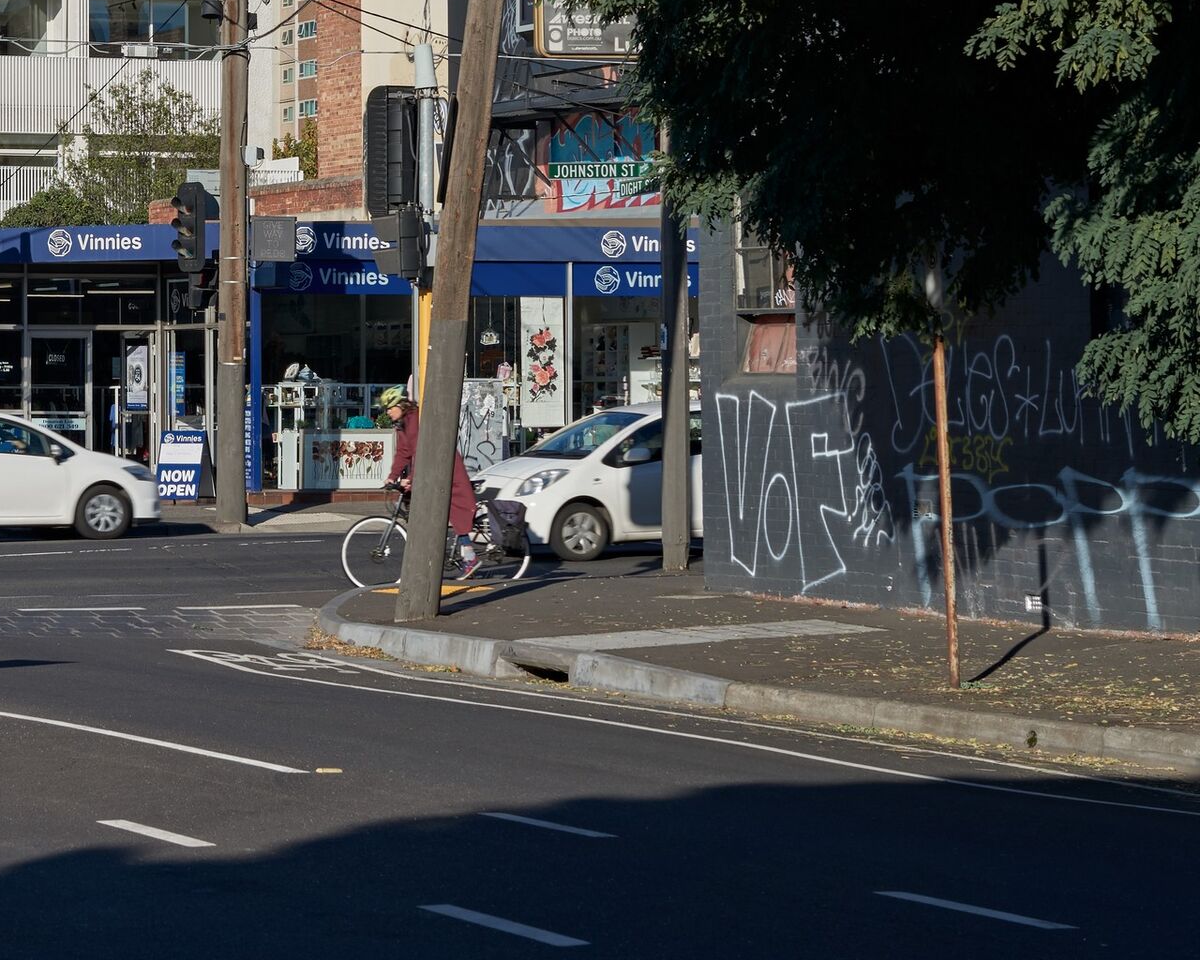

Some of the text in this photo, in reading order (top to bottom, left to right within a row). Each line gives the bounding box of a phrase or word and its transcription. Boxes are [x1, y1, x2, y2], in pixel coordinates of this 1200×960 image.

[566, 27, 602, 37] PHOTO
[554, 164, 617, 178] JOHNSTON
[621, 163, 636, 177] ST
[620, 180, 642, 196] DIGHT
[262, 221, 284, 230] GIVE
[263, 230, 283, 239] WAY
[323, 232, 391, 250] Vinnies
[77, 233, 142, 250] Vinnies
[266, 239, 280, 248] TO
[631, 236, 696, 252] Vins
[319, 268, 389, 285] Vinnies
[48, 354, 65, 362] CLOSED
[176, 435, 202, 443] Vinnies
[160, 469, 196, 482] NOW
[158, 484, 196, 497] OPEN
